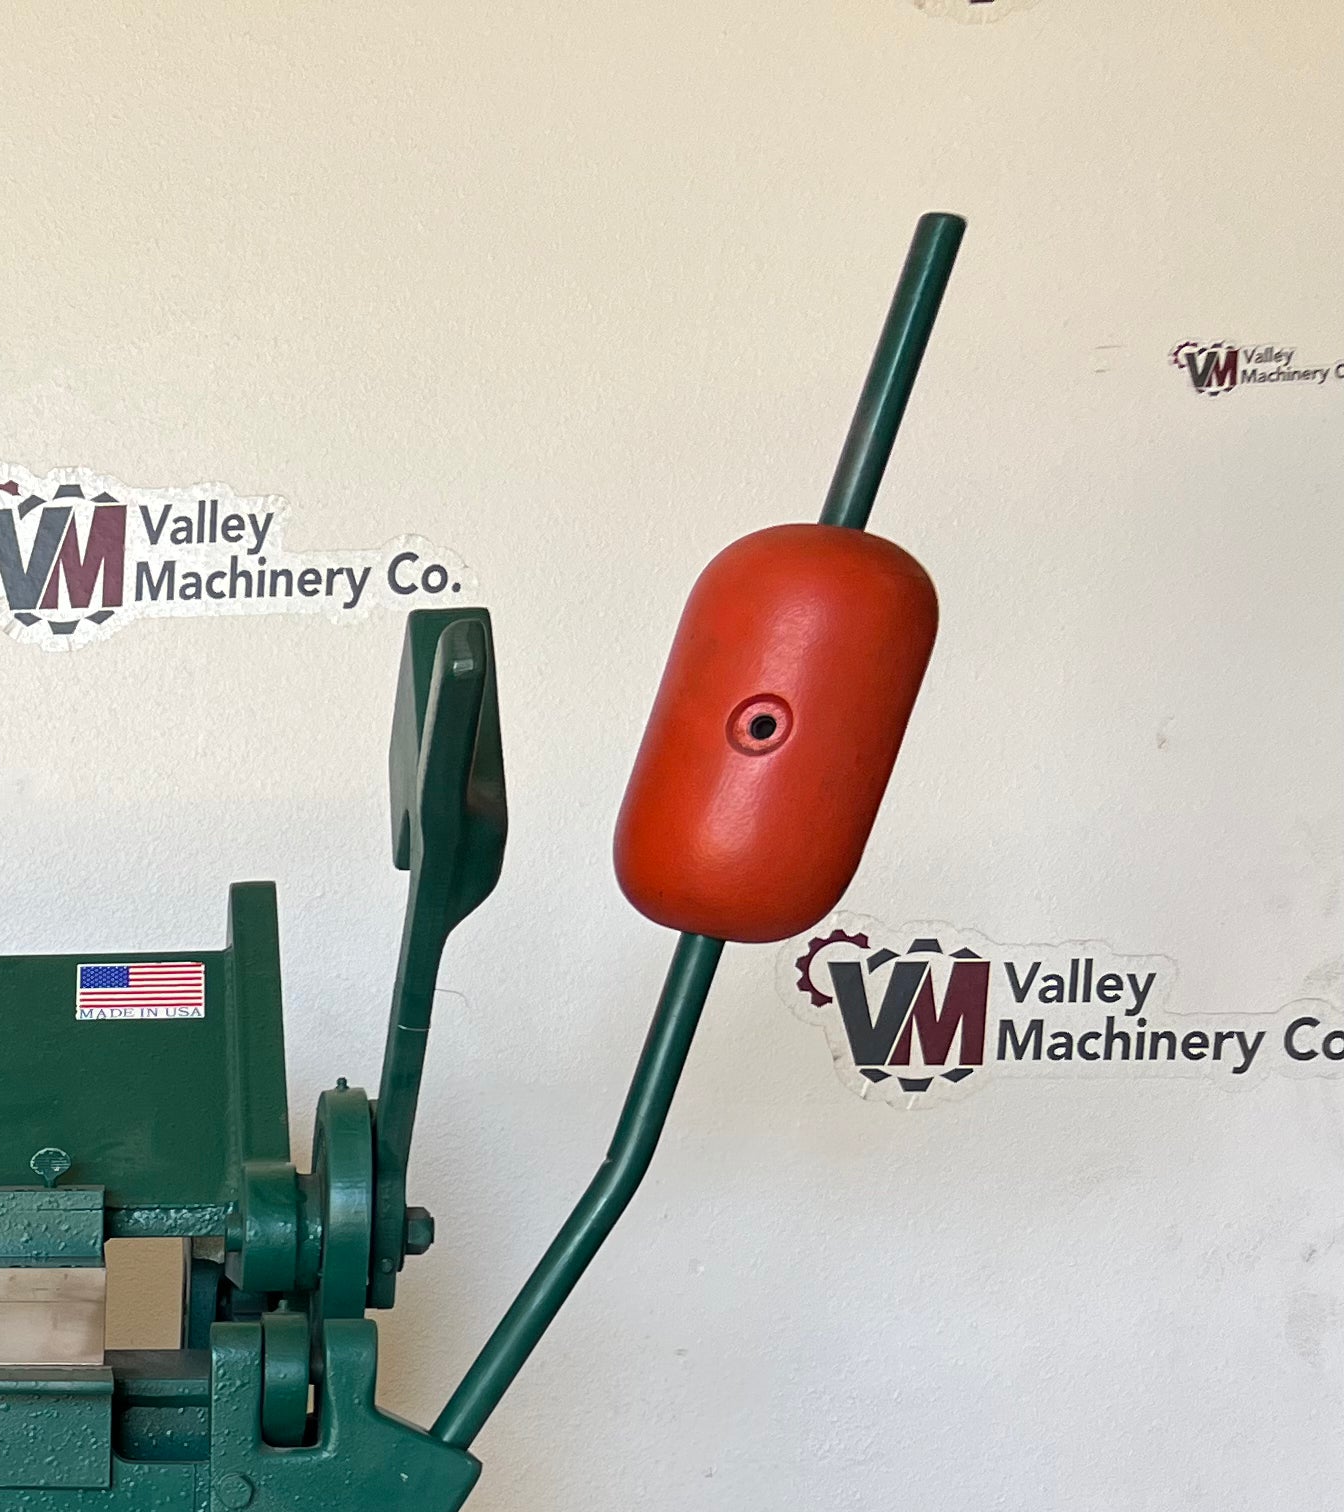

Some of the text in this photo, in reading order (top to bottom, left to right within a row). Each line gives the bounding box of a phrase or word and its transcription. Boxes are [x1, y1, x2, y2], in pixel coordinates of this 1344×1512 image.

[1184, 349, 1239, 388] VM
[1240, 364, 1331, 385] Machinery
[1243, 346, 1296, 366] Valley
[138, 500, 274, 555] Valley
[134, 552, 462, 609] Machinery Co.
[79, 1006, 202, 1019] MADE IN USA
[827, 960, 991, 1067] VM
[1003, 958, 1157, 1017] Valley
[996, 1015, 1266, 1075] Machinery
